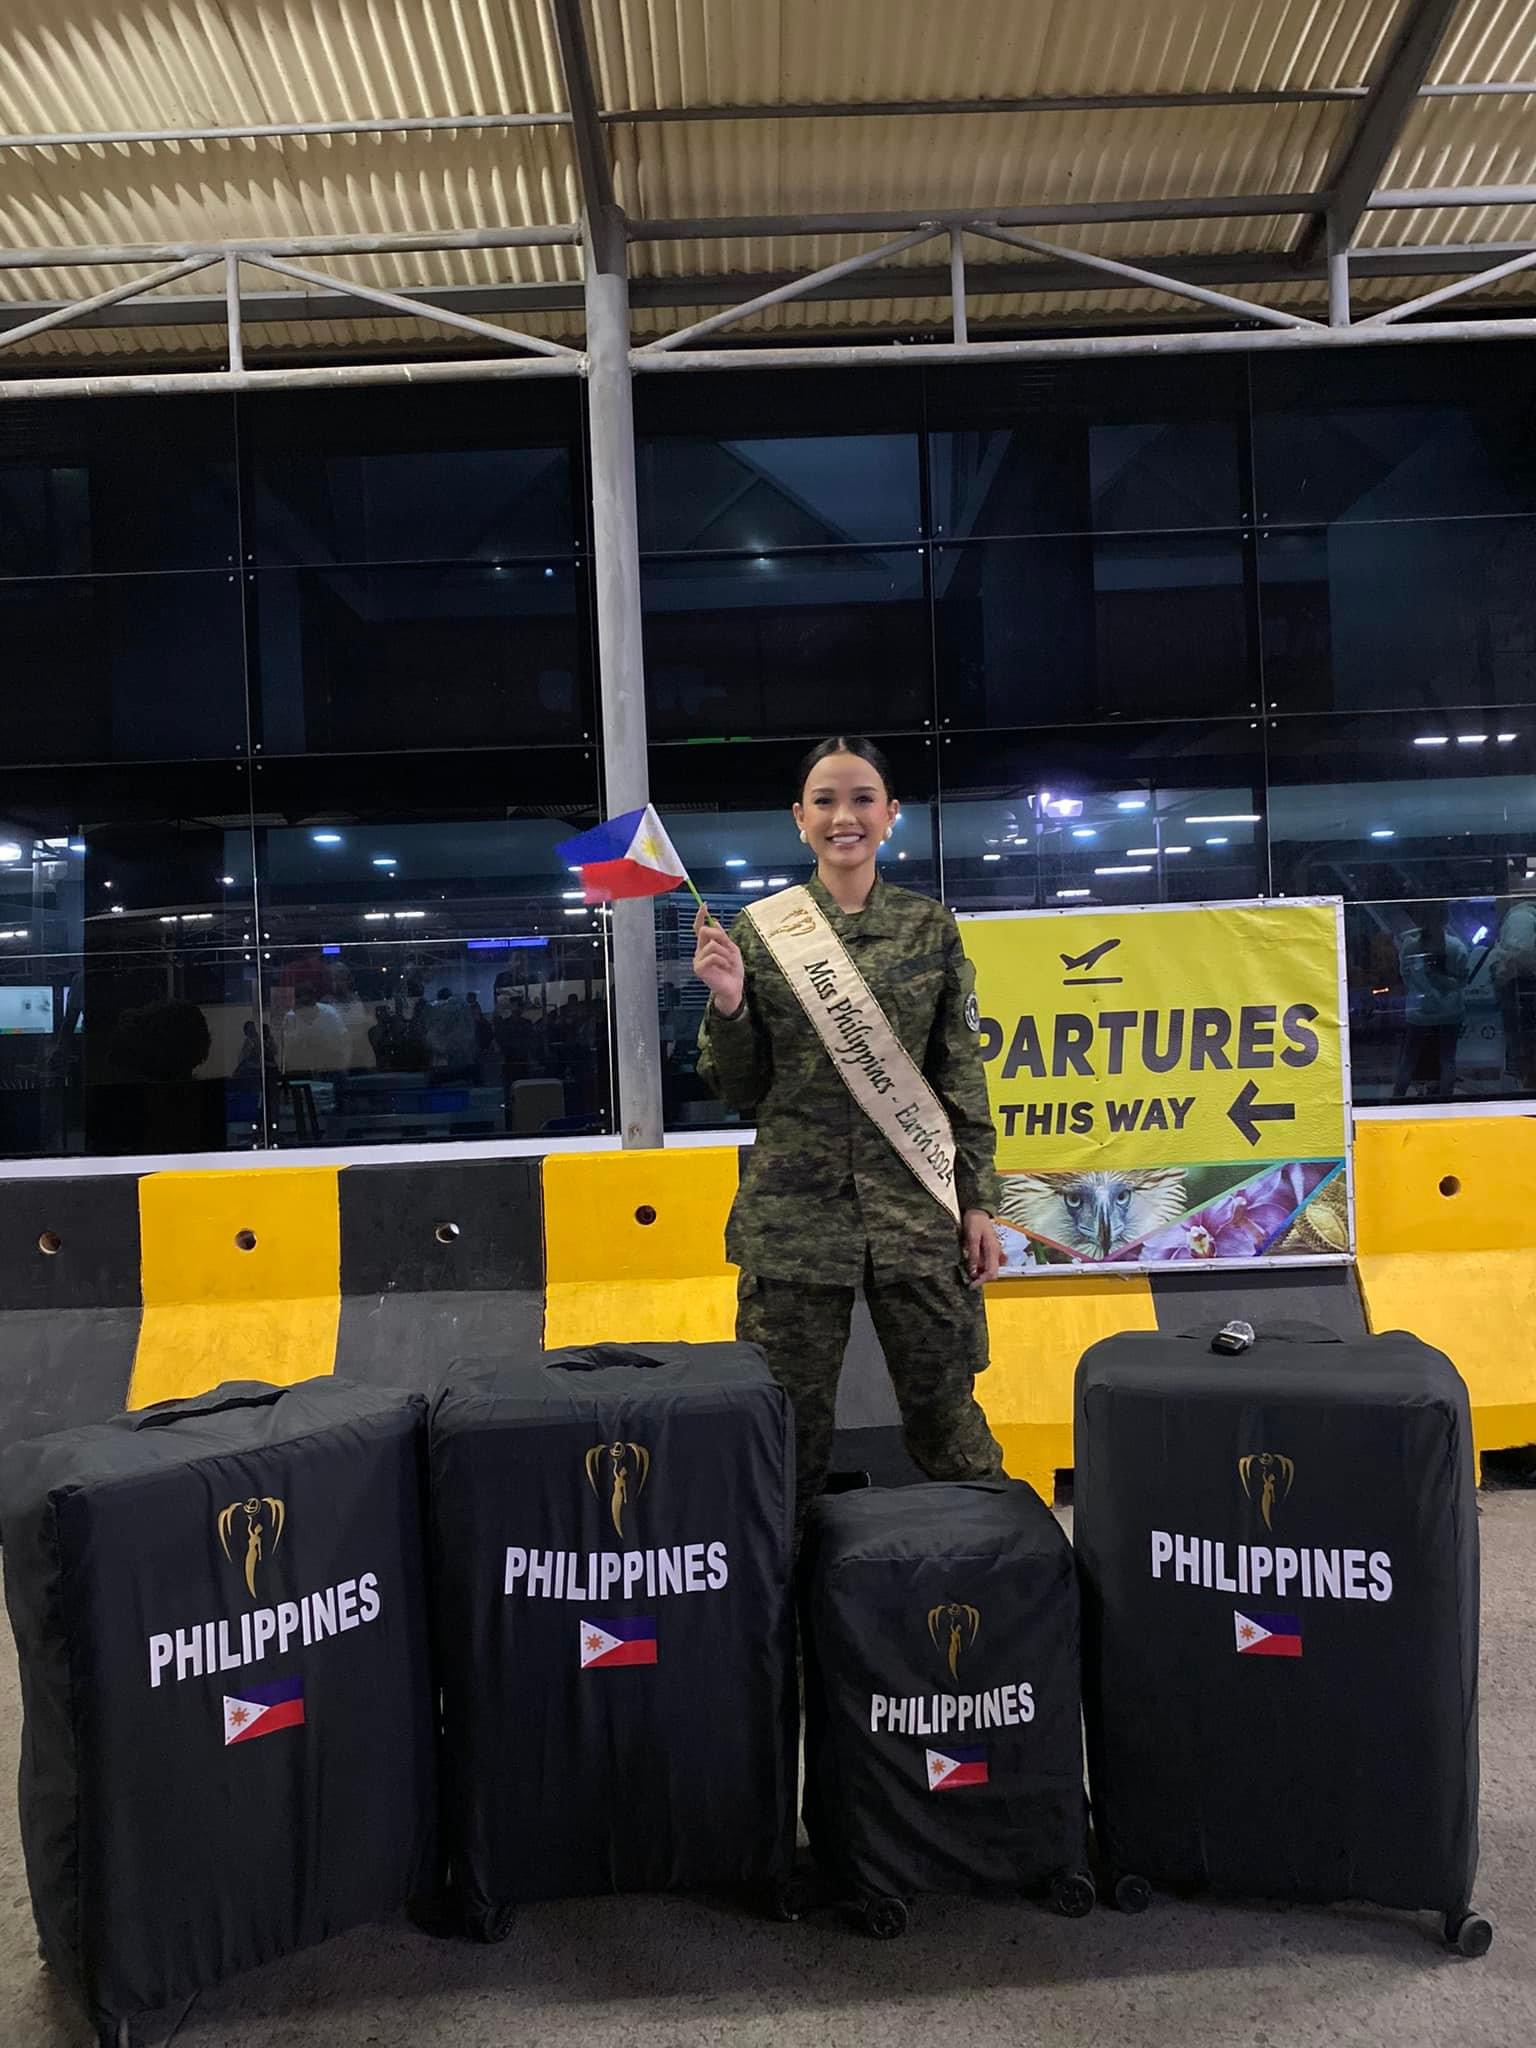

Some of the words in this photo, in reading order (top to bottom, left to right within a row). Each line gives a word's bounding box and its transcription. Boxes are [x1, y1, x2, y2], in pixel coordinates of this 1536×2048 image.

[804, 959, 838, 1001] Miss
[826, 997, 896, 1095] Philippines
[894, 1102, 940, 1153] Earth
[925, 1143, 954, 1189] 2024
[999, 1102, 1095, 1137] THIS
[1106, 1096, 1196, 1133] WAY
[504, 1541, 728, 1601] PHILIPPINES
[1152, 1530, 1393, 1602] PHILIPPINES
[149, 1572, 380, 1688] PHILIPPINES
[869, 1682, 1035, 1735] PHILIPPINES
